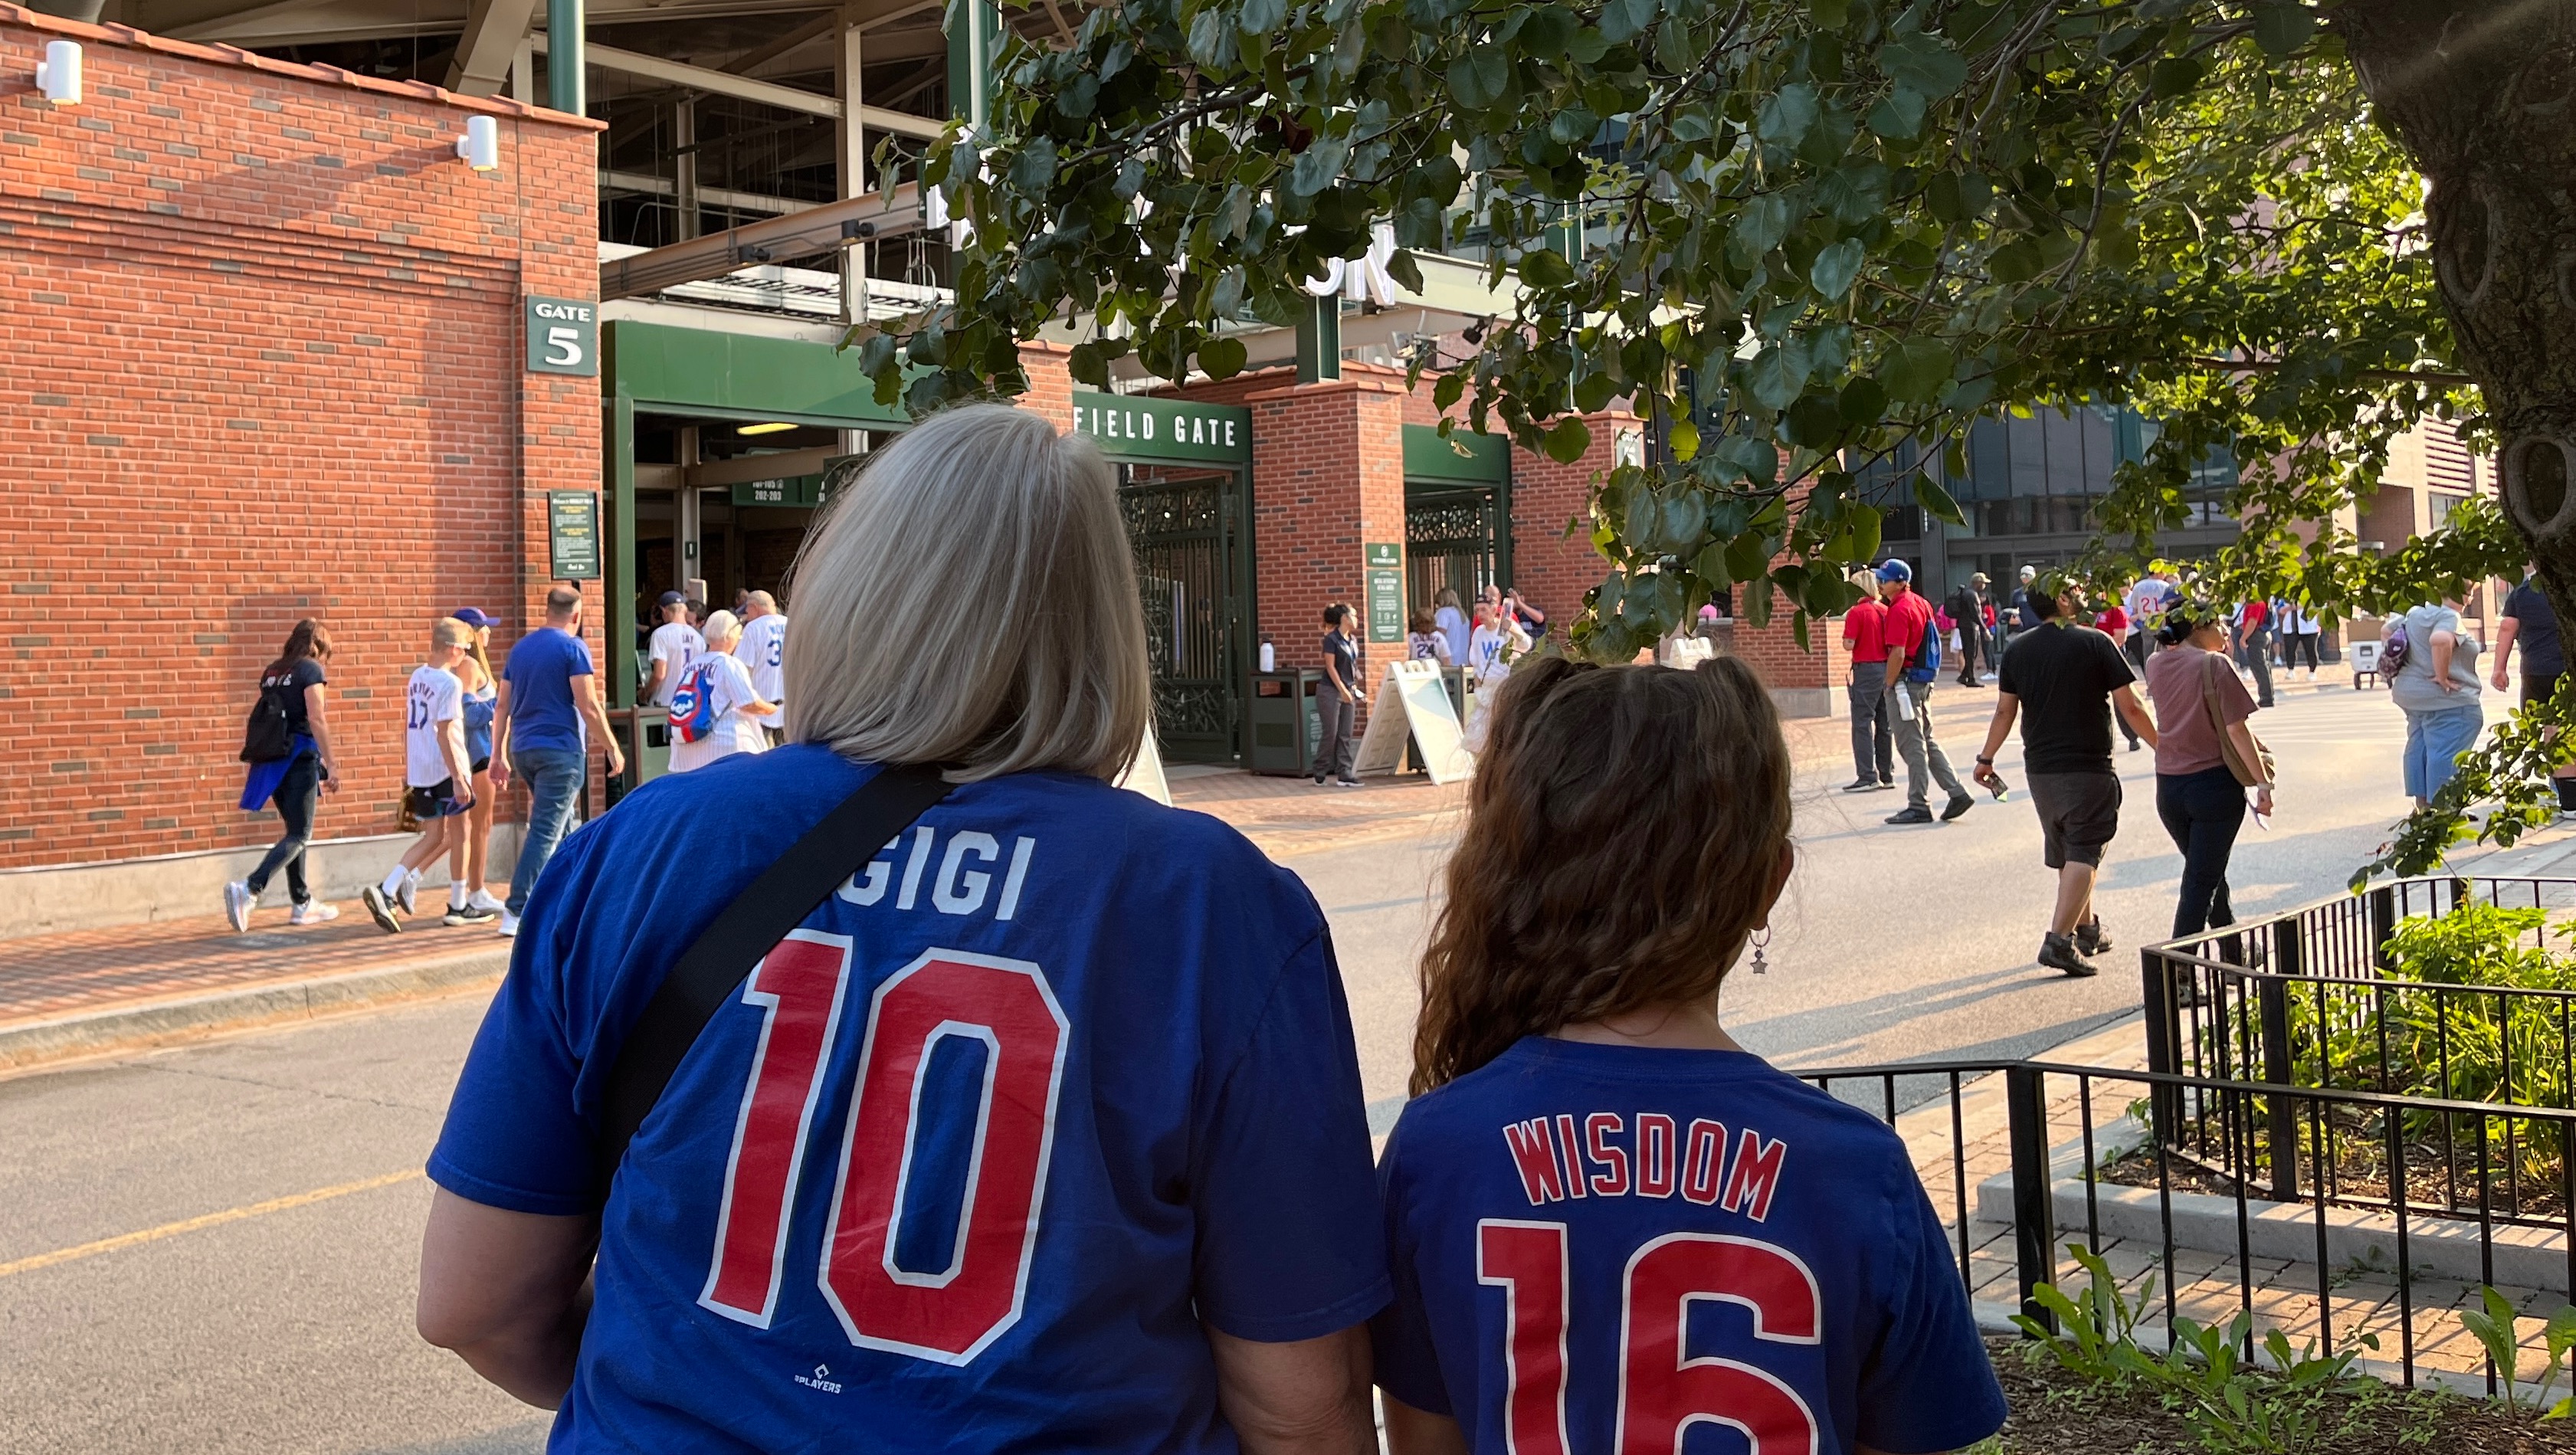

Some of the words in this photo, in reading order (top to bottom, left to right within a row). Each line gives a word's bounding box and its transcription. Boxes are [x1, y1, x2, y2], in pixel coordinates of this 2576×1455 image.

[535, 303, 591, 323] GATE
[545, 327, 583, 366] 5
[1073, 406, 1155, 440] FIELD
[1175, 415, 1236, 447] GATE
[755, 490, 782, 501] 202-203
[2141, 596, 2160, 614] 21
[1481, 641, 1501, 660] W
[408, 699, 428, 730] 17
[696, 928, 1071, 1368] 10
[1503, 1112, 1788, 1224] WISDOM
[1476, 1218, 1822, 1455] 16
